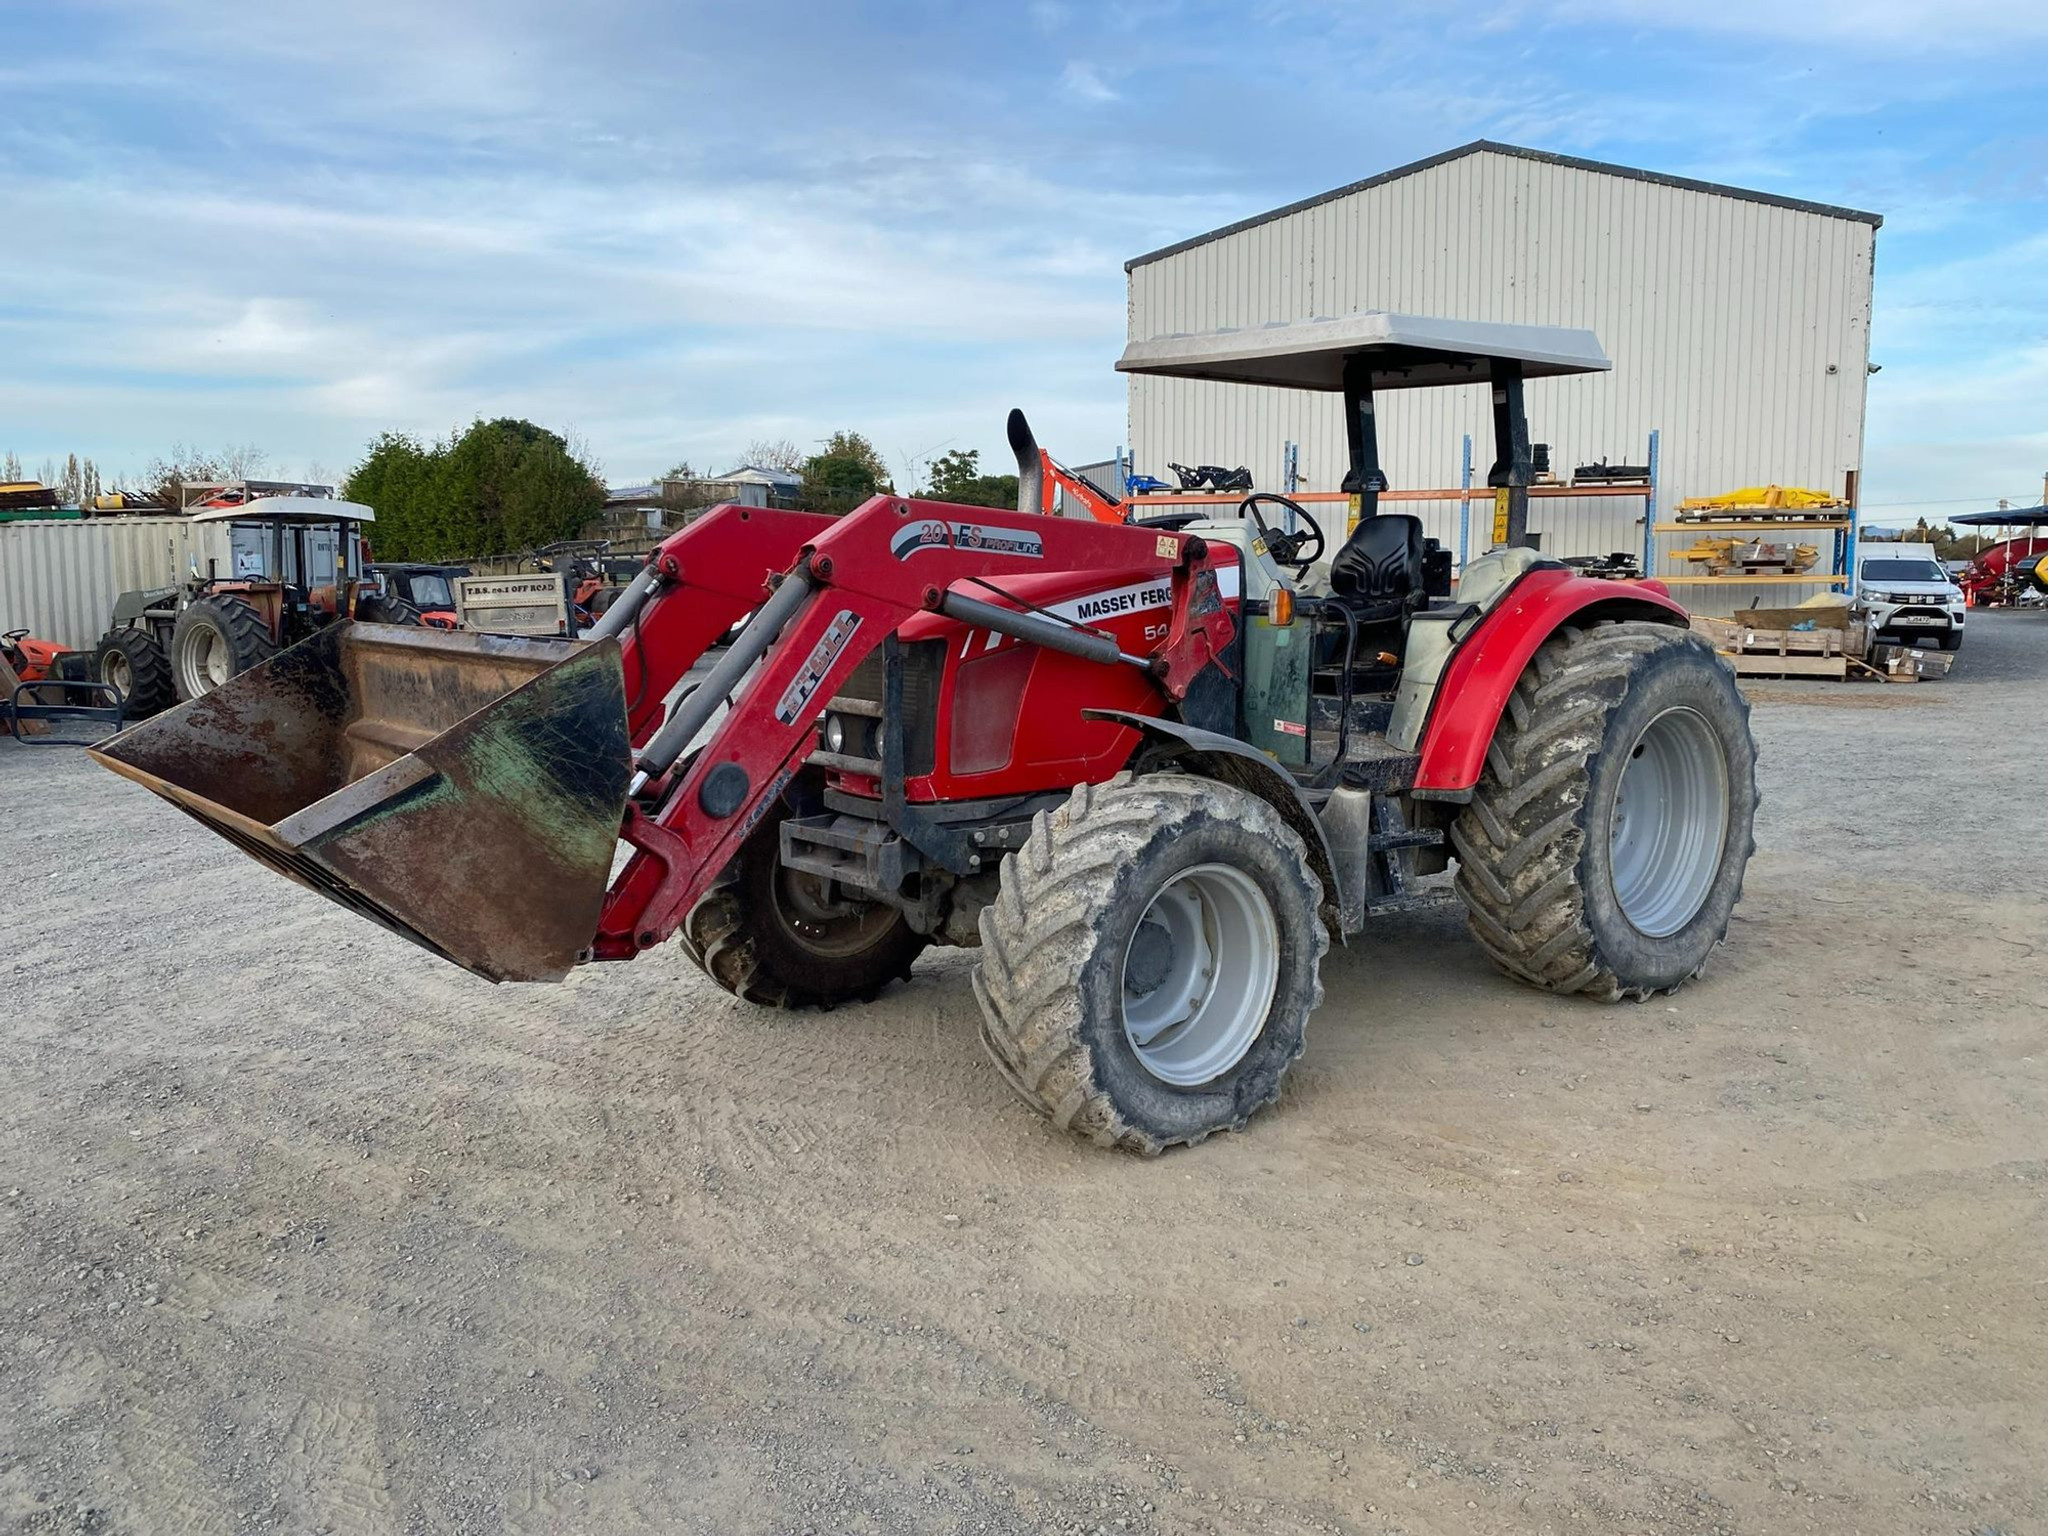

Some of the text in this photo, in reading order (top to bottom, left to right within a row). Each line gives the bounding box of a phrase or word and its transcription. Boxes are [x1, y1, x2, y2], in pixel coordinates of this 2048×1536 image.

[920, 524, 1040, 554] 20 FS PROFILINE
[511, 585, 528, 593] OFF
[530, 584, 555, 592] ROAD
[1077, 593, 1136, 619] MASSEY
[1144, 623, 1168, 641] 54
